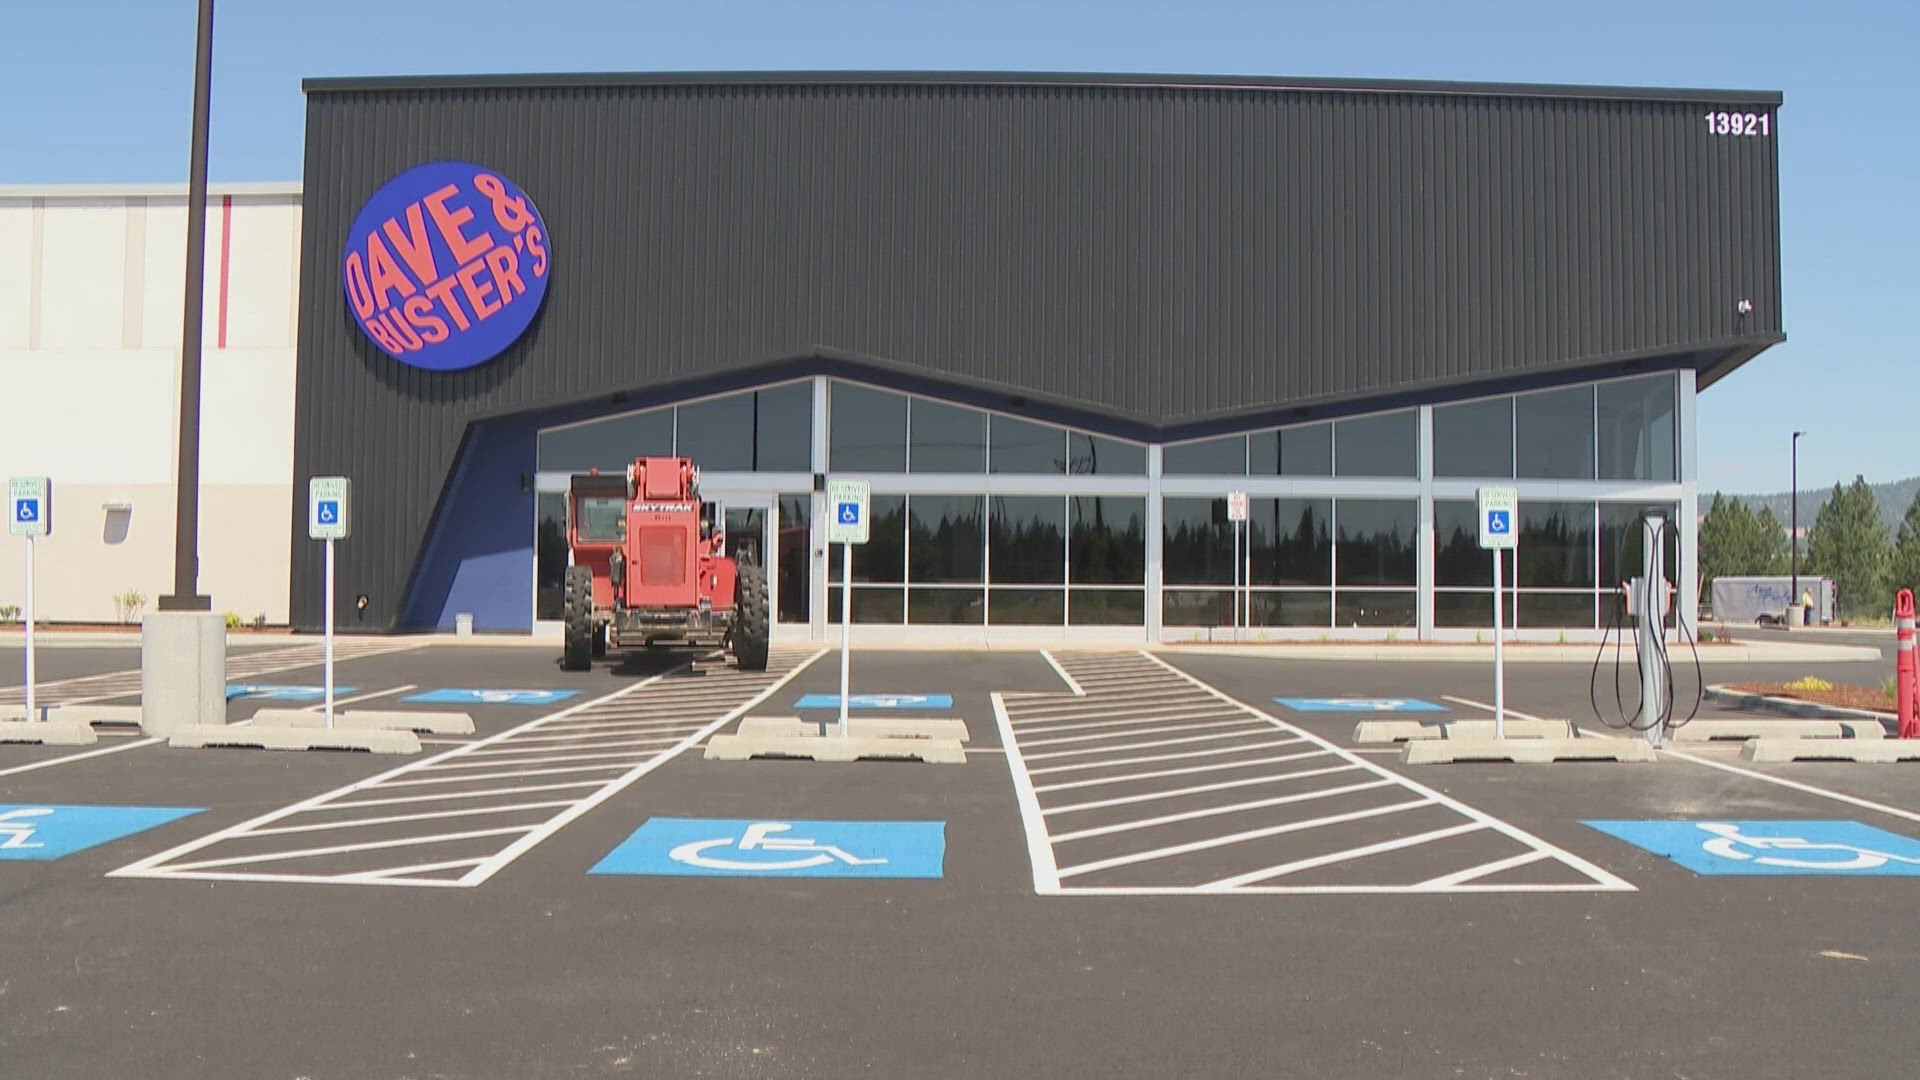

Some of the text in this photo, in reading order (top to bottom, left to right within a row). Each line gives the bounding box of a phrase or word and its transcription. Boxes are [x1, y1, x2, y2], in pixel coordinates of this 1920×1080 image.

[1704, 111, 1769, 136] 13921
[346, 173, 536, 321] DAVE &
[365, 225, 548, 354] BUSTER'S
